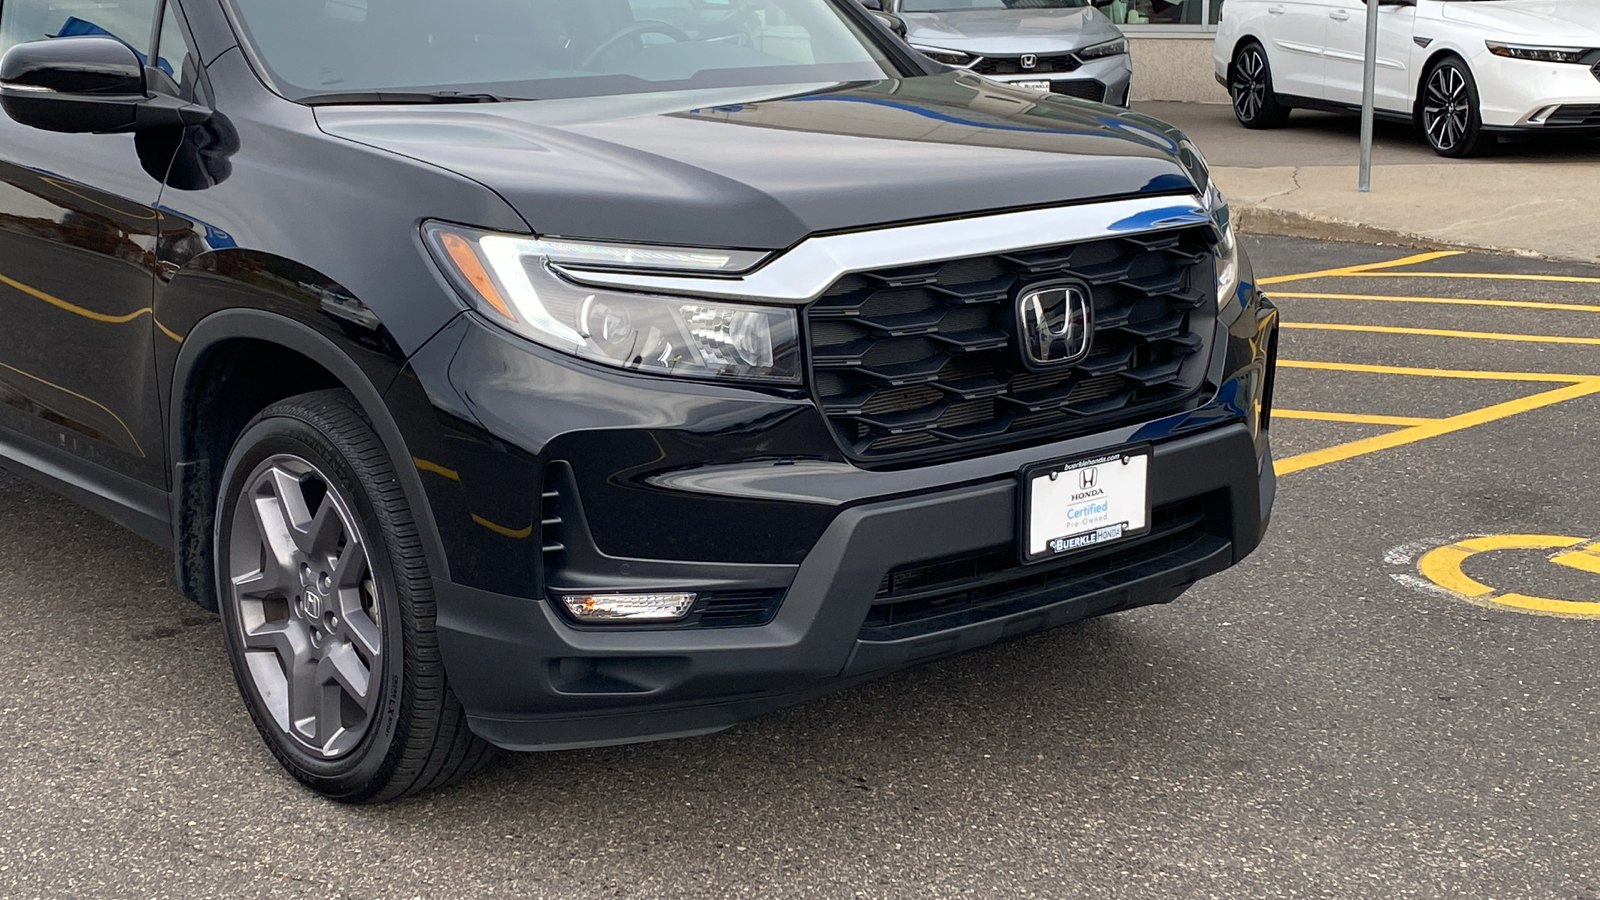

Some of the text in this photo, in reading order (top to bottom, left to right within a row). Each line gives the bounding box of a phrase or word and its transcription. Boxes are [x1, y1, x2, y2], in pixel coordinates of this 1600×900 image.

[1071, 488, 1104, 501] HONDA
[1067, 500, 1107, 519] Certified
[1066, 514, 1107, 528] Pre-Owned
[1056, 533, 1097, 551] BUERKLE
[1097, 526, 1120, 541] HONDA
